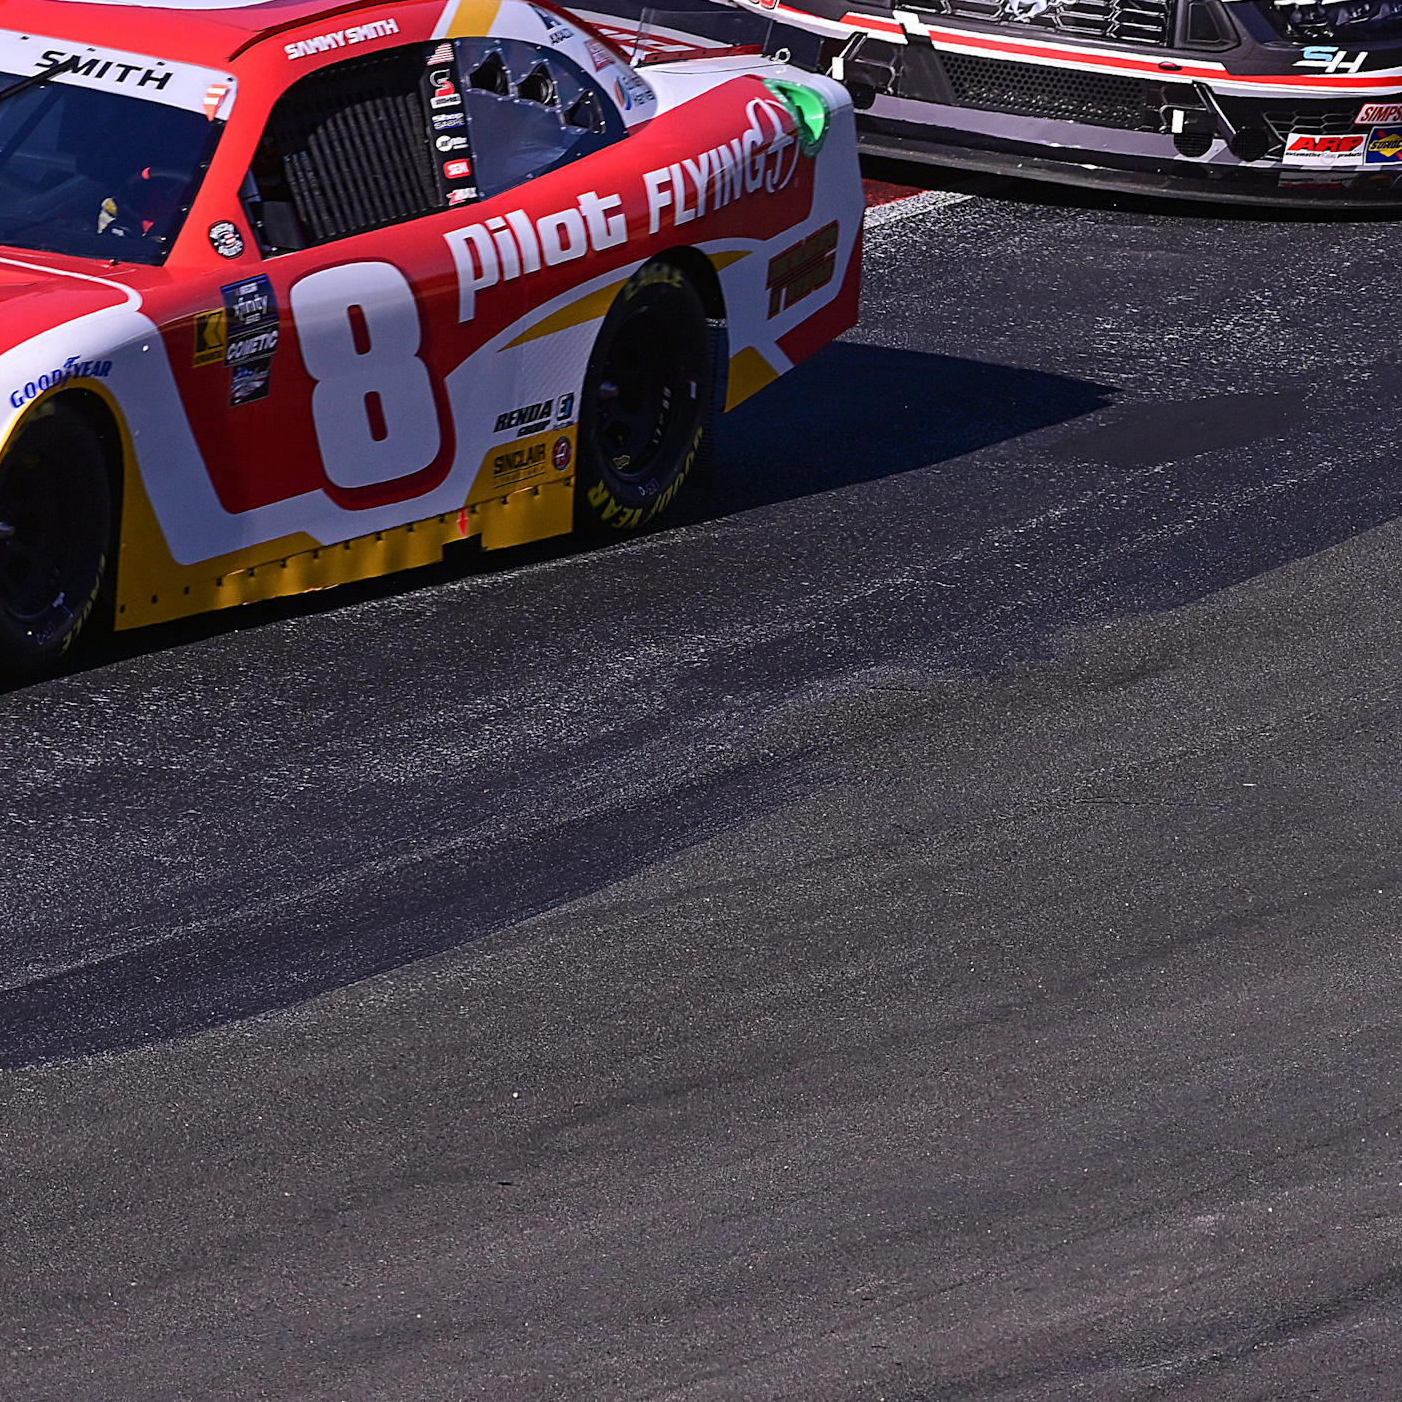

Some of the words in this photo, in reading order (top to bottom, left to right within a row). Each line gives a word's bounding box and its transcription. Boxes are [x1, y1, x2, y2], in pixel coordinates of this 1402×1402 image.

[284, 32, 347, 60] SAMMY
[345, 18, 399, 45] SMITH
[35, 49, 174, 91] SMITH
[1287, 136, 1364, 152] ARP
[643, 127, 766, 235] FLYING
[227, 330, 279, 361] COMETIC
[10, 355, 112, 409] GOODYEAR
[290, 261, 442, 490] 8
[493, 399, 555, 433] RENDA
[494, 443, 546, 475] SINCLAIR
